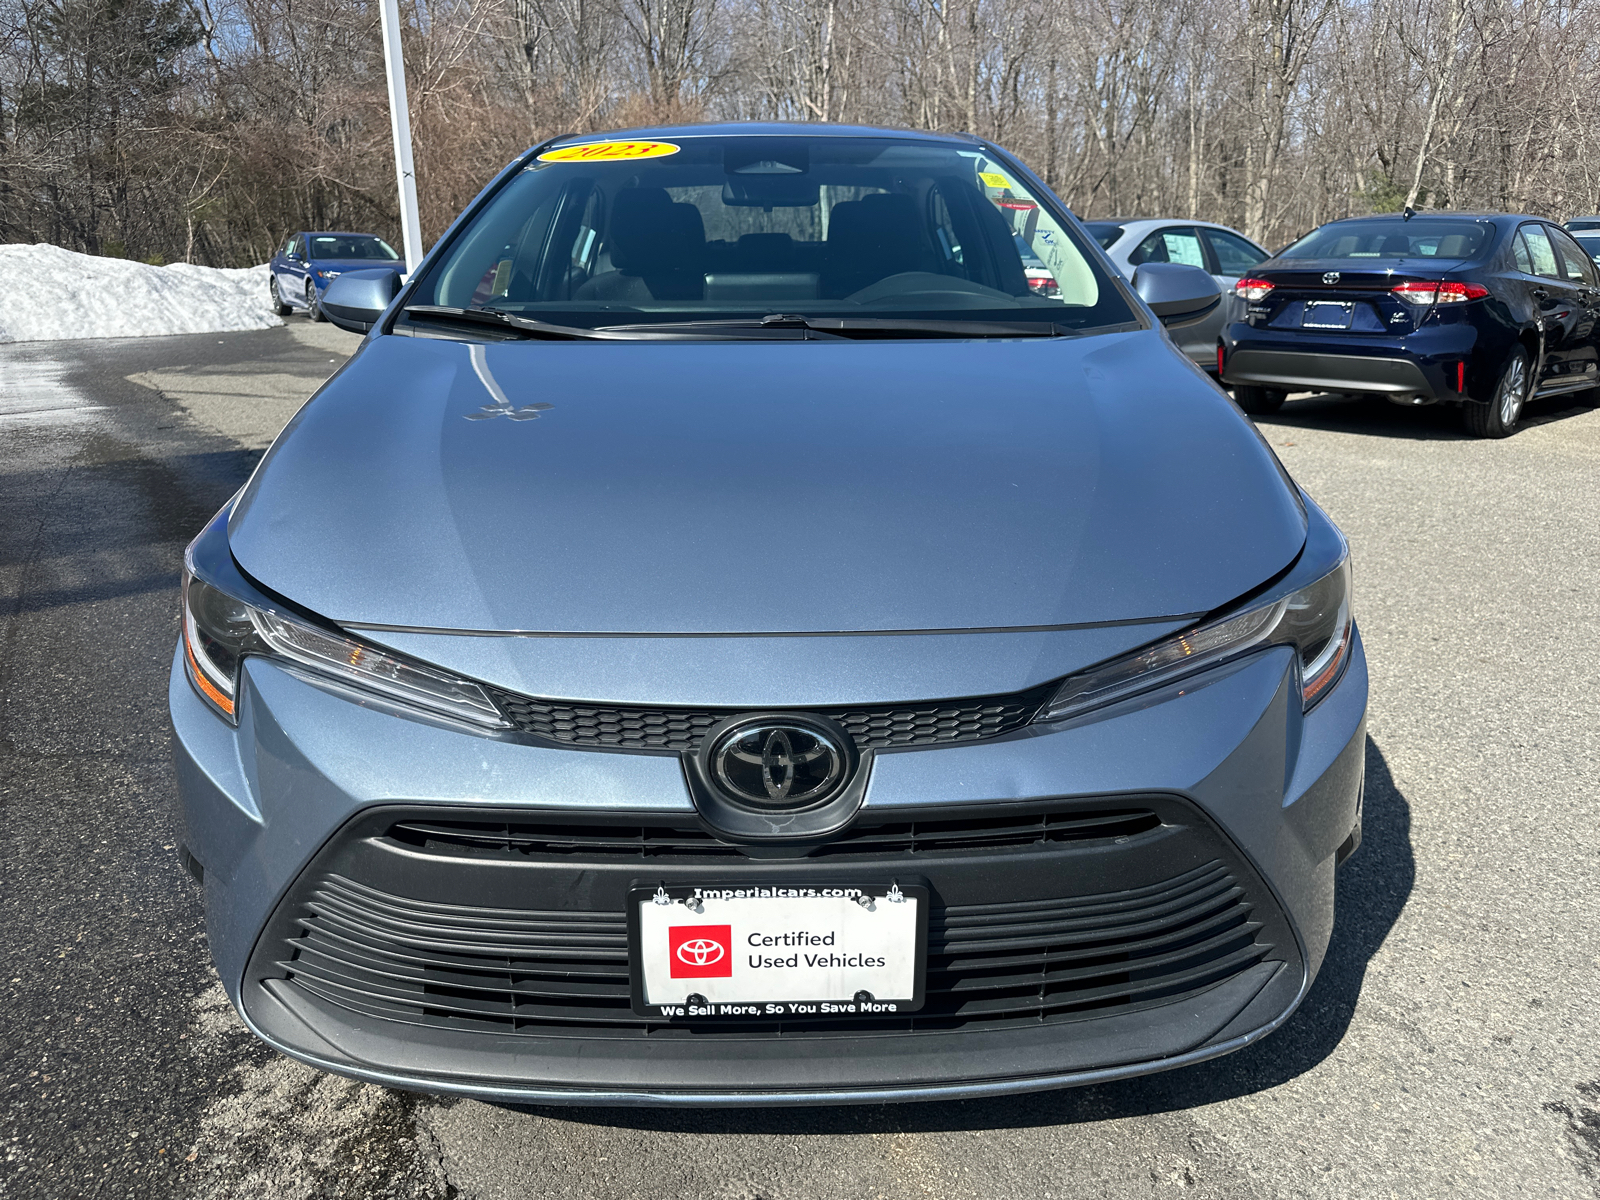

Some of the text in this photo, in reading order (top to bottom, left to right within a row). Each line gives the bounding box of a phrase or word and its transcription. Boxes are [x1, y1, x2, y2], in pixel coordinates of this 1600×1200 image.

[555, 145, 659, 160] 2023
[694, 886, 863, 901] Imperialcars.com
[747, 931, 835, 947] Certified
[748, 952, 886, 969] Used Vehicles
[660, 1002, 898, 1017] We Sell More, So You Save More
